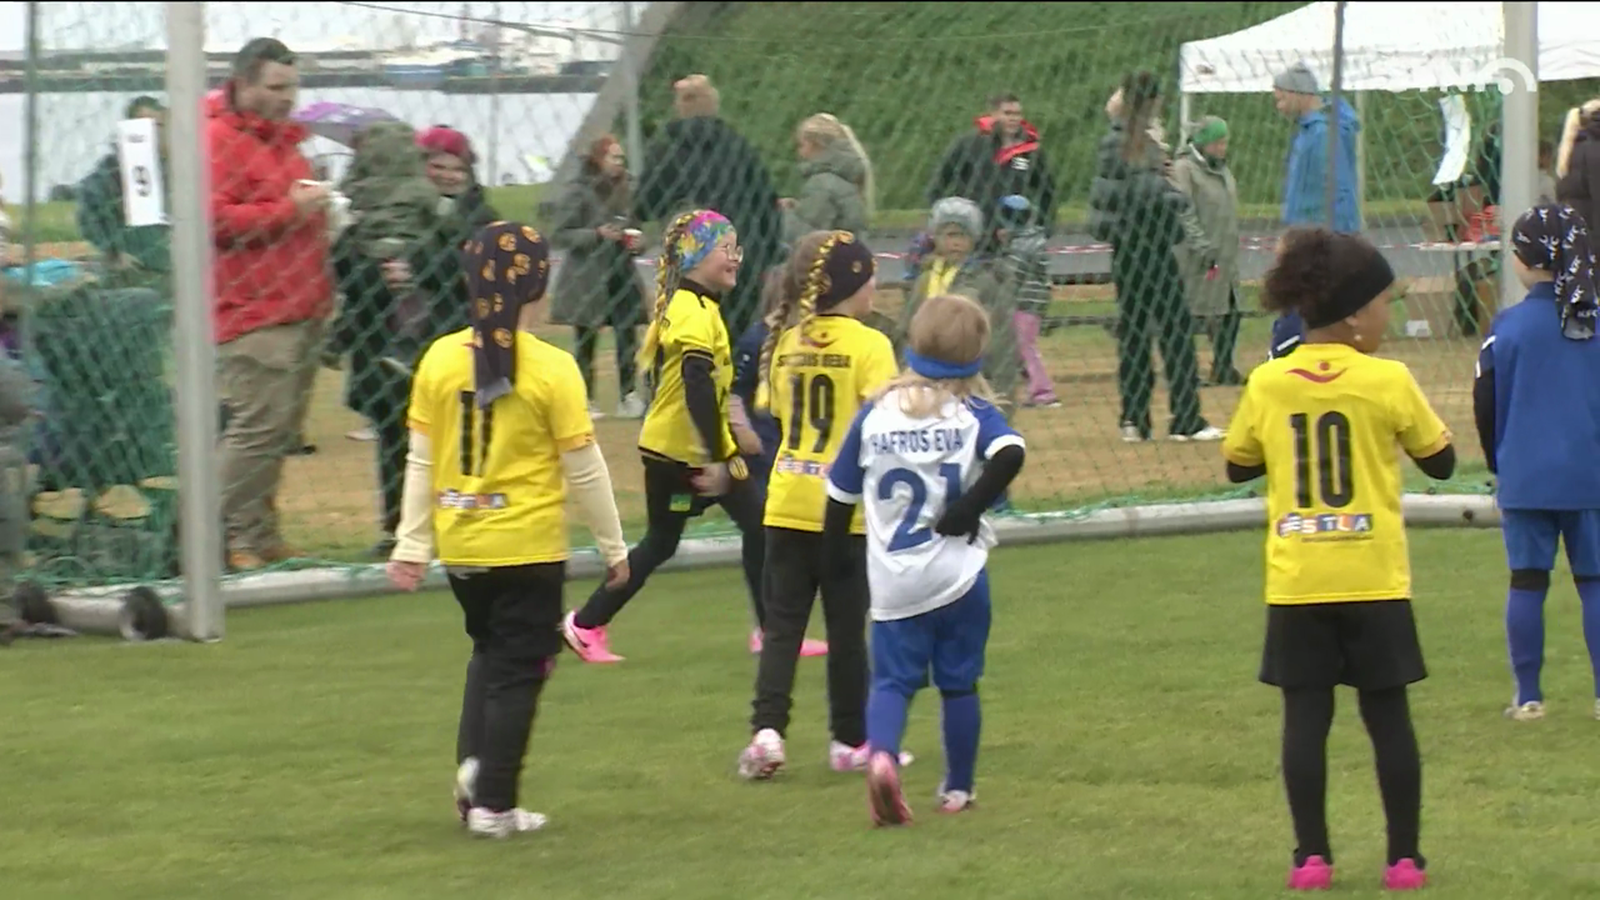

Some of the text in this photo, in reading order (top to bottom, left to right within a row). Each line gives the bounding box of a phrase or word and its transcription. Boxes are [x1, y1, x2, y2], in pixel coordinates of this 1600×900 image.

[787, 373, 835, 453] 19
[933, 428, 964, 452] EVA
[1289, 410, 1354, 509] 10
[877, 462, 962, 553] 21
